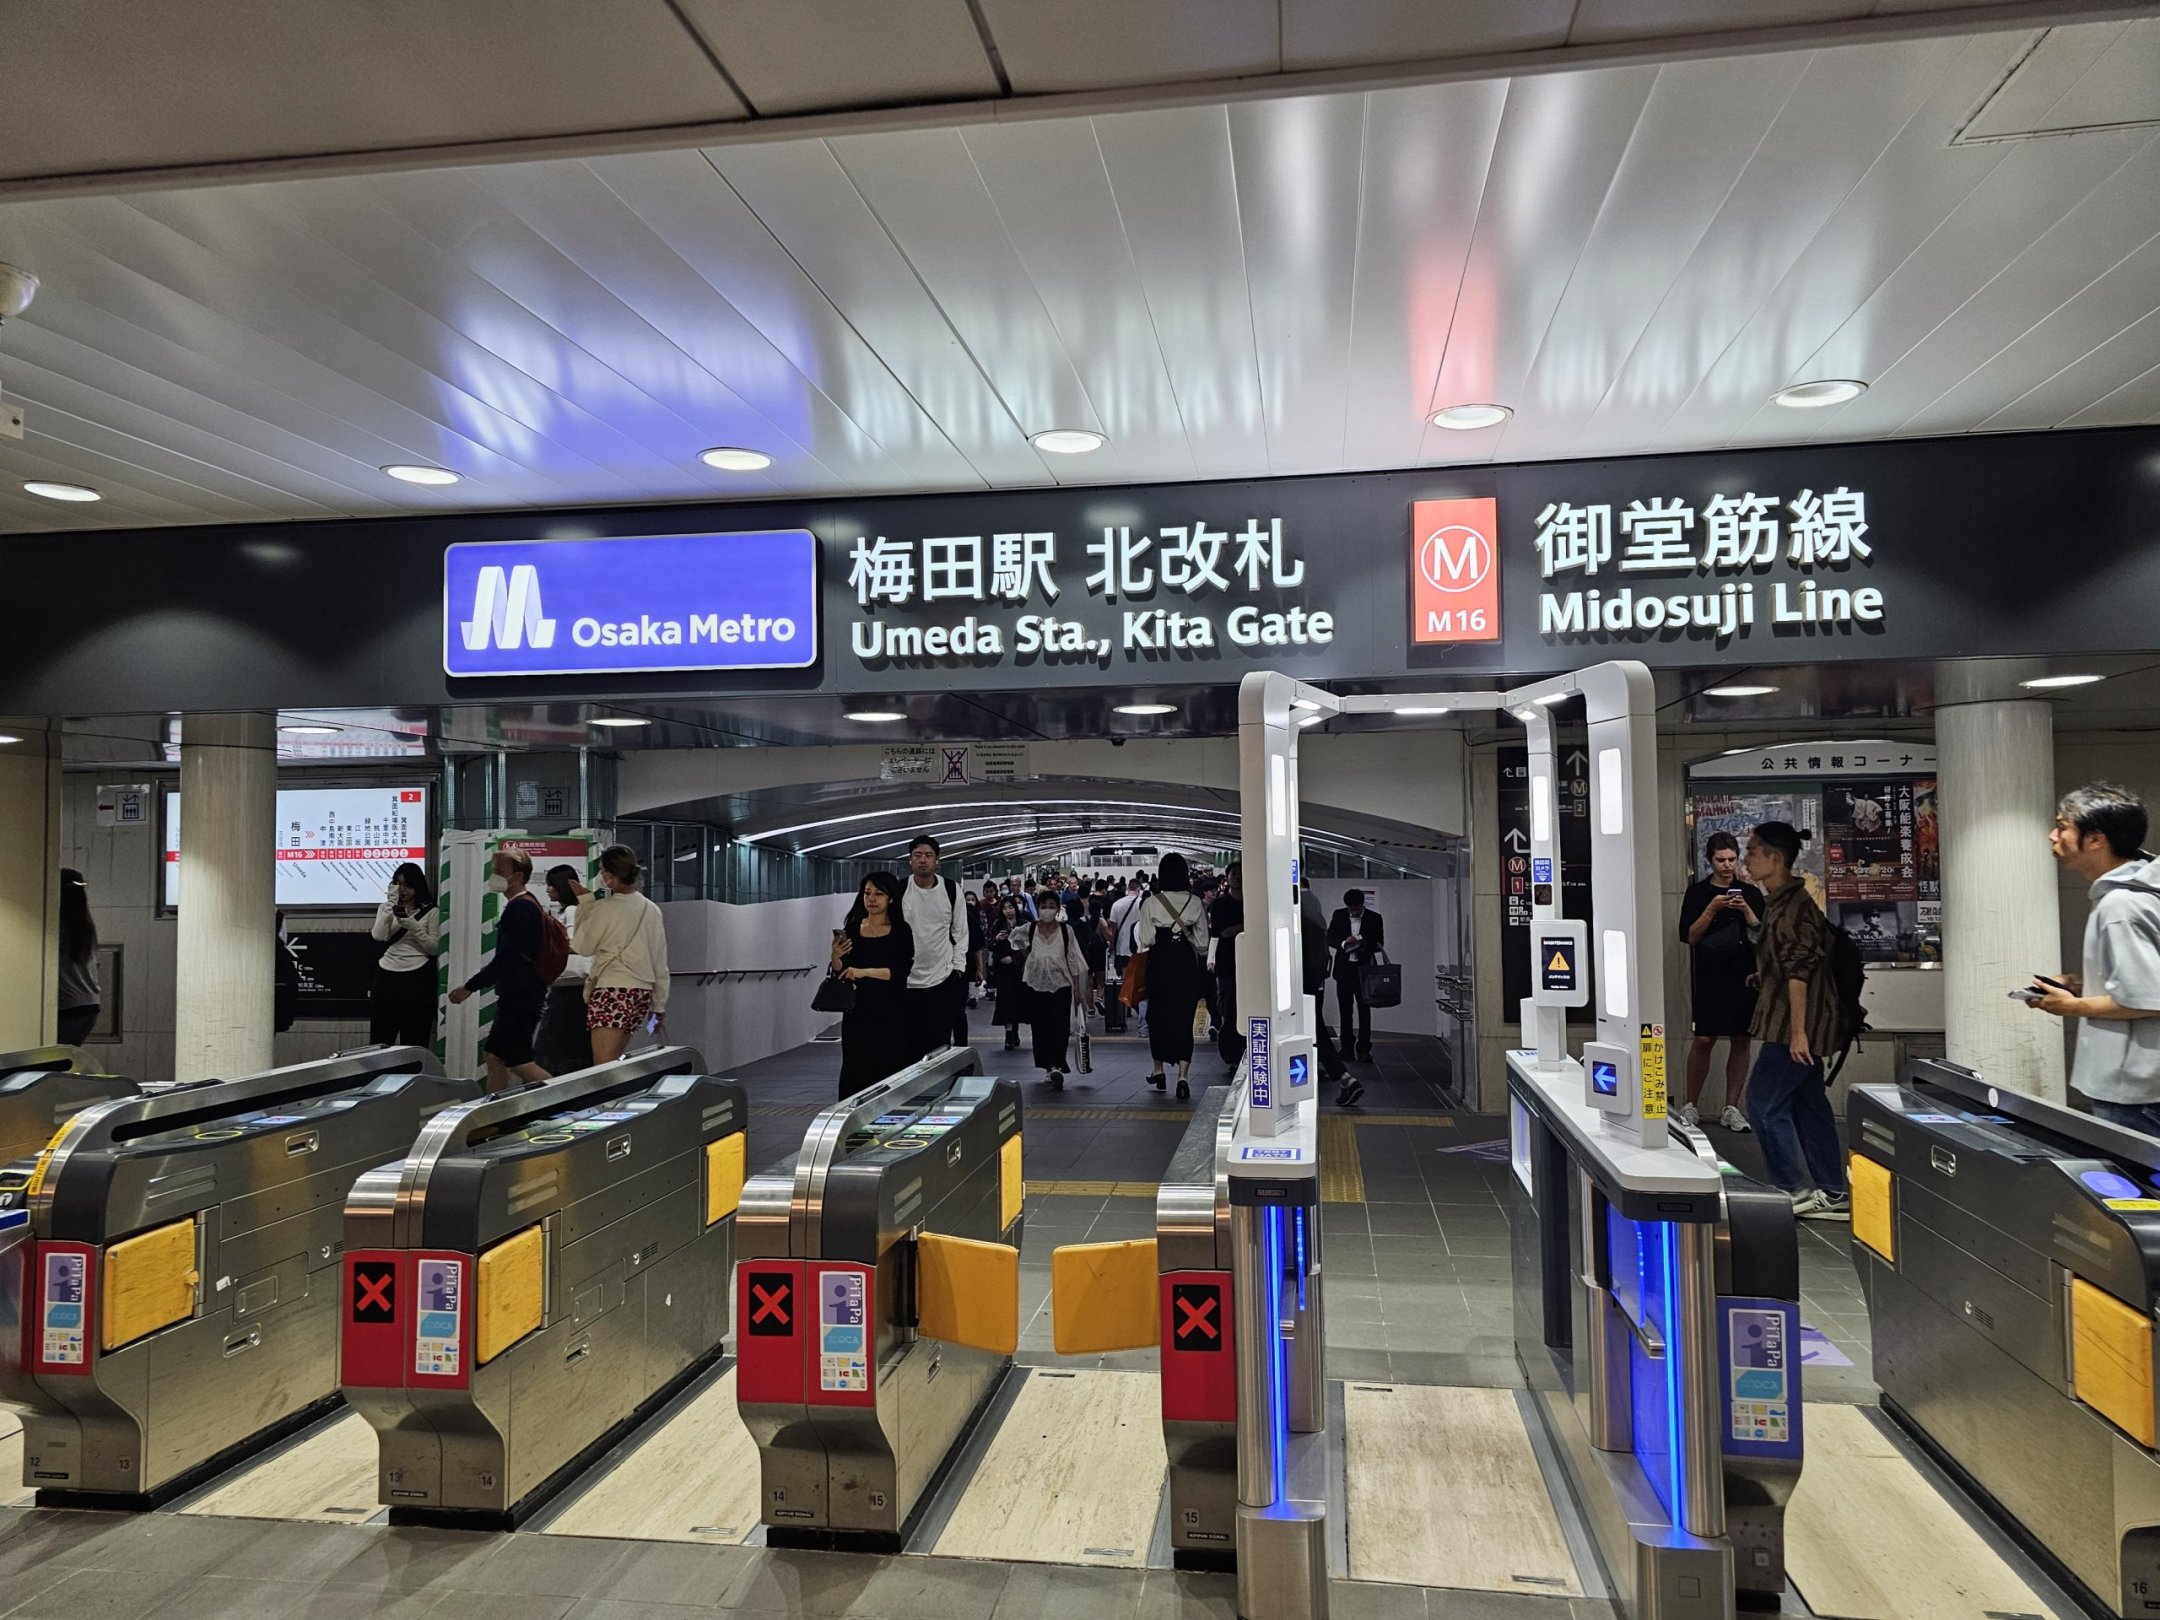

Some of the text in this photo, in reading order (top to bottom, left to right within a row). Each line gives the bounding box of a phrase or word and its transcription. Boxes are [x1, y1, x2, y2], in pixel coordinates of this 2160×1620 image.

[1535, 487, 1872, 577] 御堂筋線
[849, 517, 1305, 604] 梅田駅 北改札
[1427, 608, 1487, 633] M16
[1539, 579, 1884, 635] Midosuji Line
[572, 613, 796, 647] Osaka Metro
[851, 606, 1334, 658] Umeda Sta., Kita Gate
[1762, 754, 1937, 771] 公共情報コーナー
[291, 821, 300, 847] 梅田
[1899, 786, 1913, 878] 大阪能楽養成会
[1252, 1022, 1268, 1102] 実証実験中
[1643, 1043, 1654, 1114] 扉にご注意
[1654, 1043, 1667, 1114] かけこみ禁止
[446, 1265, 458, 1310] PiTaPa
[849, 1277, 861, 1323] PiTaPa
[1766, 1316, 1781, 1367] PiTaPa
[30, 1457, 40, 1467] 12
[120, 1459, 130, 1469] 13
[482, 1475, 493, 1487] 14
[774, 1491, 784, 1501] 14
[873, 1495, 884, 1506] 15
[1185, 1512, 1198, 1523] 15
[2132, 1582, 2148, 1594] 16
